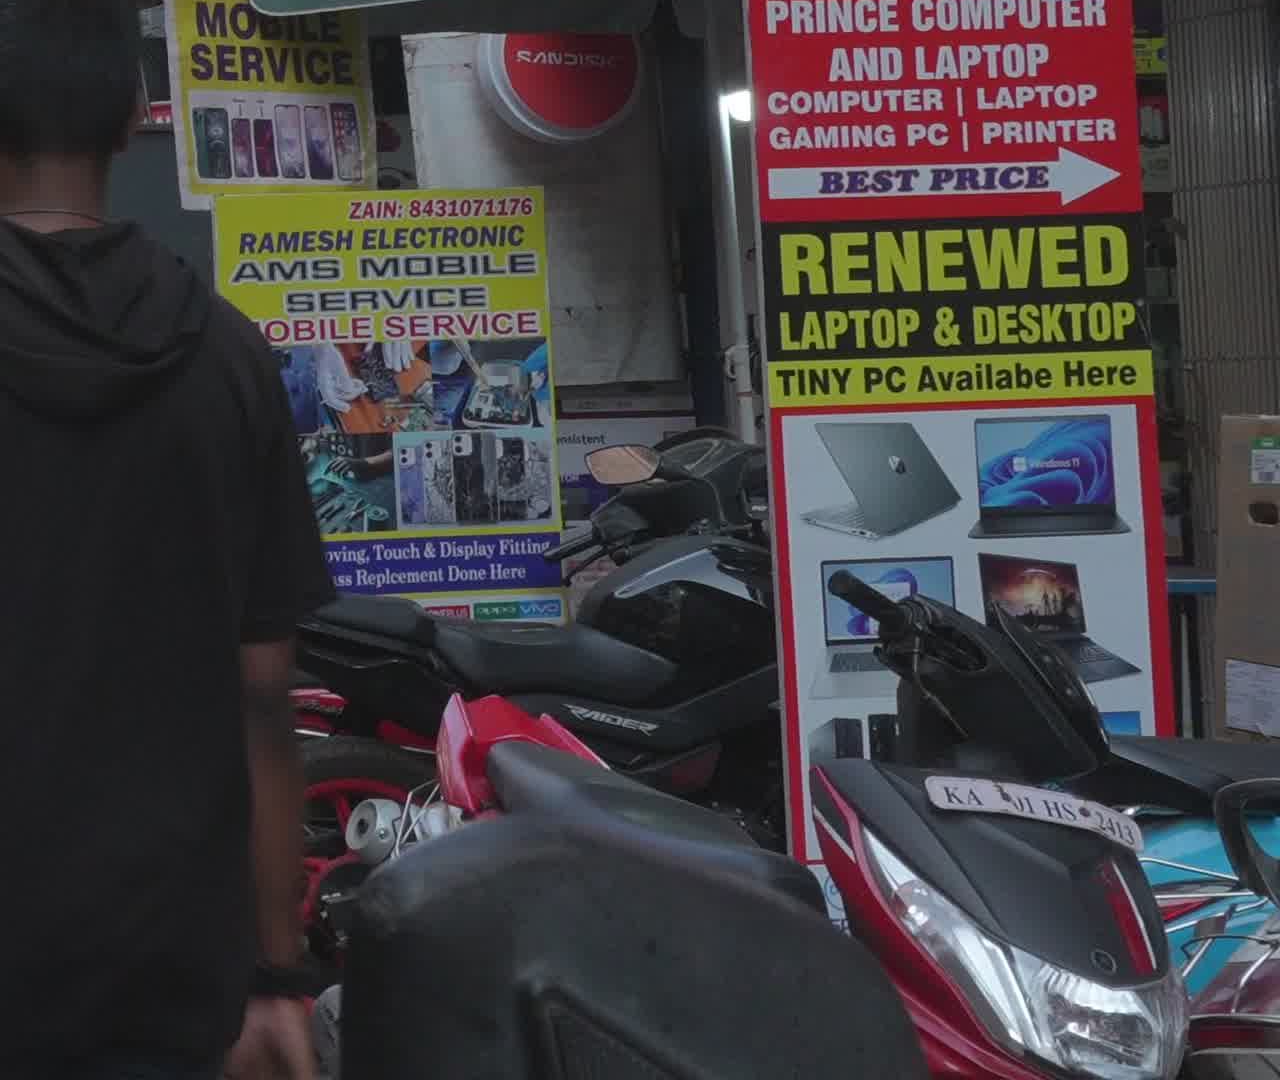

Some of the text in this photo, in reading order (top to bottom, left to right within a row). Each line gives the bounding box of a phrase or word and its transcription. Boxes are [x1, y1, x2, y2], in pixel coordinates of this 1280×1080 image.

[191, 43, 355, 85] SERVICE
[828, 43, 1049, 83] AND LAPTOP
[767, 84, 1098, 115] COMPUTER LAPTOP
[769, 118, 1117, 150] GAMING PC PRINTER
[818, 166, 1050, 195] BEST PRICE
[348, 197, 533, 221] ZAIN: 8431071176
[239, 224, 525, 255] RAMESH ELECTRONIC
[231, 253, 537, 284] AMS MOBILE
[779, 224, 1130, 296] RENEWED
[286, 286, 487, 313] SERVICE
[384, 311, 539, 337] SERVICE
[779, 302, 1137, 351] LAPTOP & DESKTOP
[776, 360, 1138, 397] TINY PC Availabe Here
[372, 542, 421, 561] Touch
[423, 543, 436, 561] &
[447, 541, 496, 565] Display
[499, 537, 551, 560] Fitting
[355, 564, 527, 589] Replcement Done Here
[561, 703, 660, 737] RAIDER
[943, 785, 1137, 847] KA HS 2413
